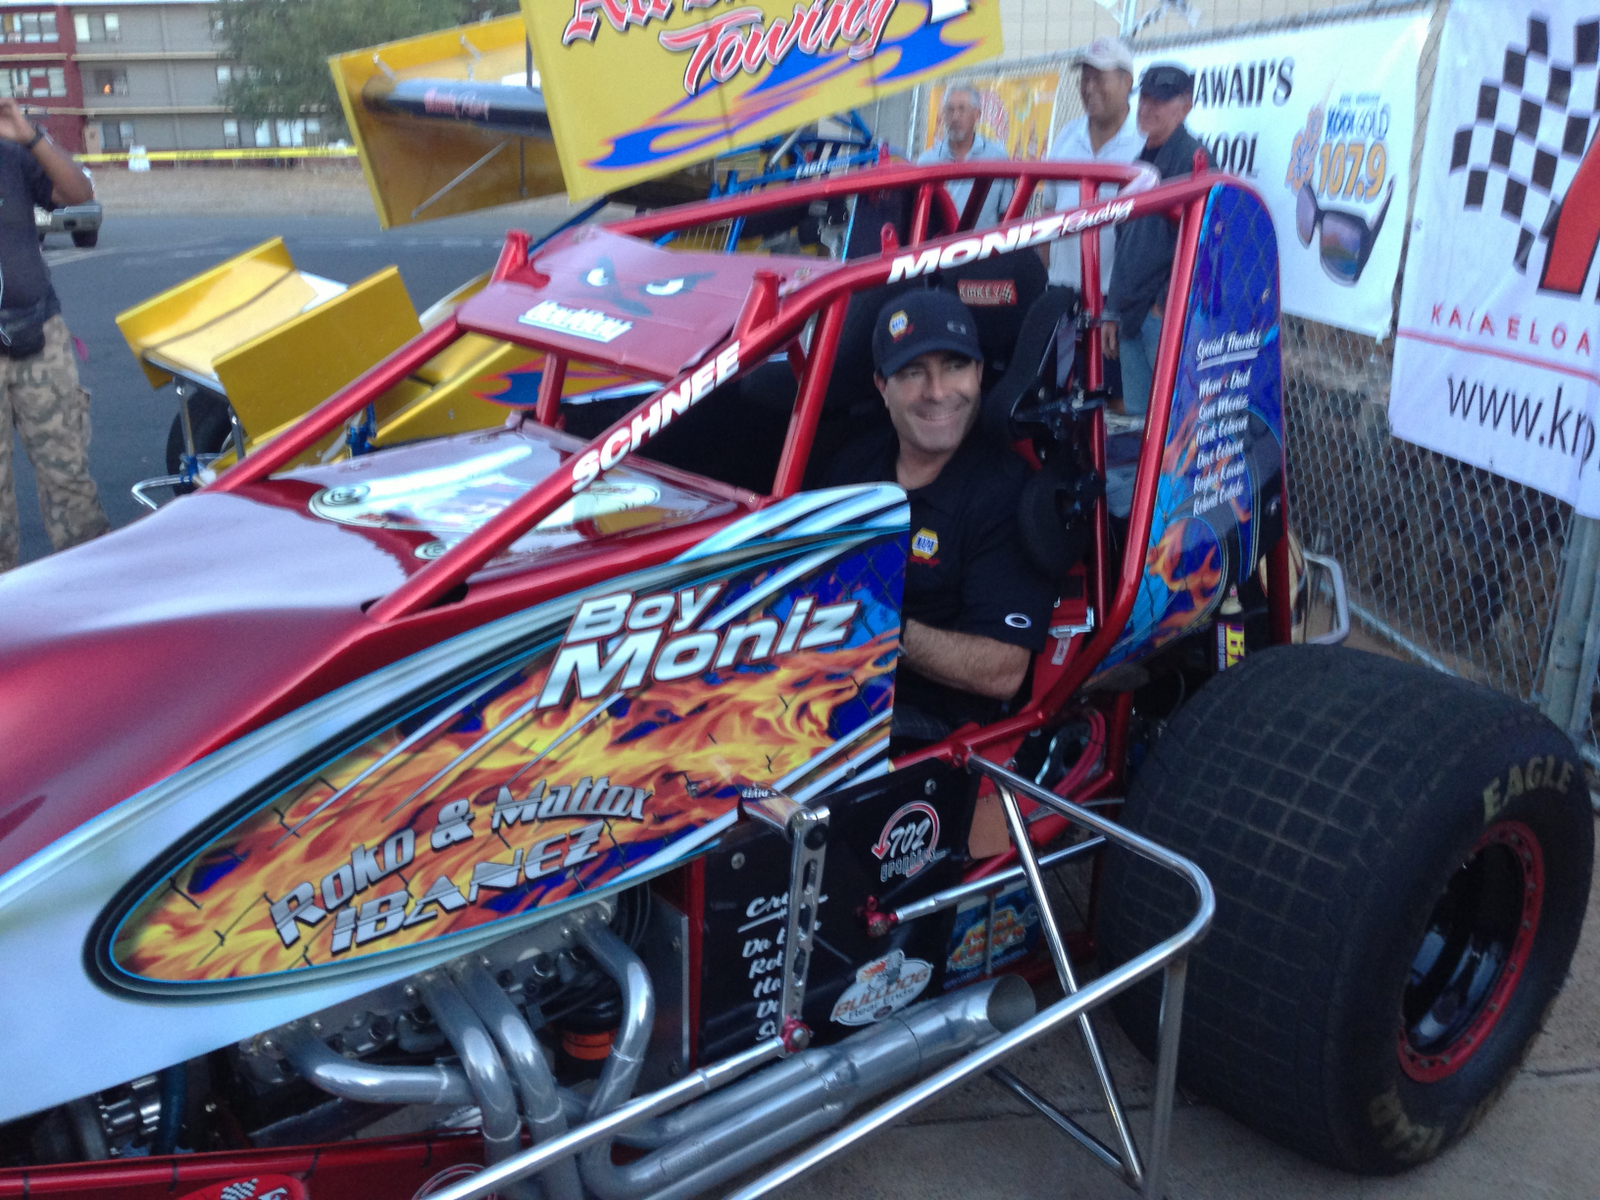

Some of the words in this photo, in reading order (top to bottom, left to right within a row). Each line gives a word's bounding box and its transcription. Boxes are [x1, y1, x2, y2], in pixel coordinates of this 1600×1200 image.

[658, 0, 897, 95] Towing
[1189, 56, 1295, 109] AWAII'S
[1318, 141, 1387, 203] 107.9
[887, 213, 1064, 284] MONIZ
[959, 283, 1001, 298] KIRKEY
[572, 340, 739, 493] SCHNEE
[564, 580, 729, 645] Boy
[534, 596, 861, 711] Moniz
[1483, 754, 1575, 825] EAGLE
[269, 828, 415, 949] Roko
[430, 797, 476, 853] &
[890, 817, 931, 858] 702
